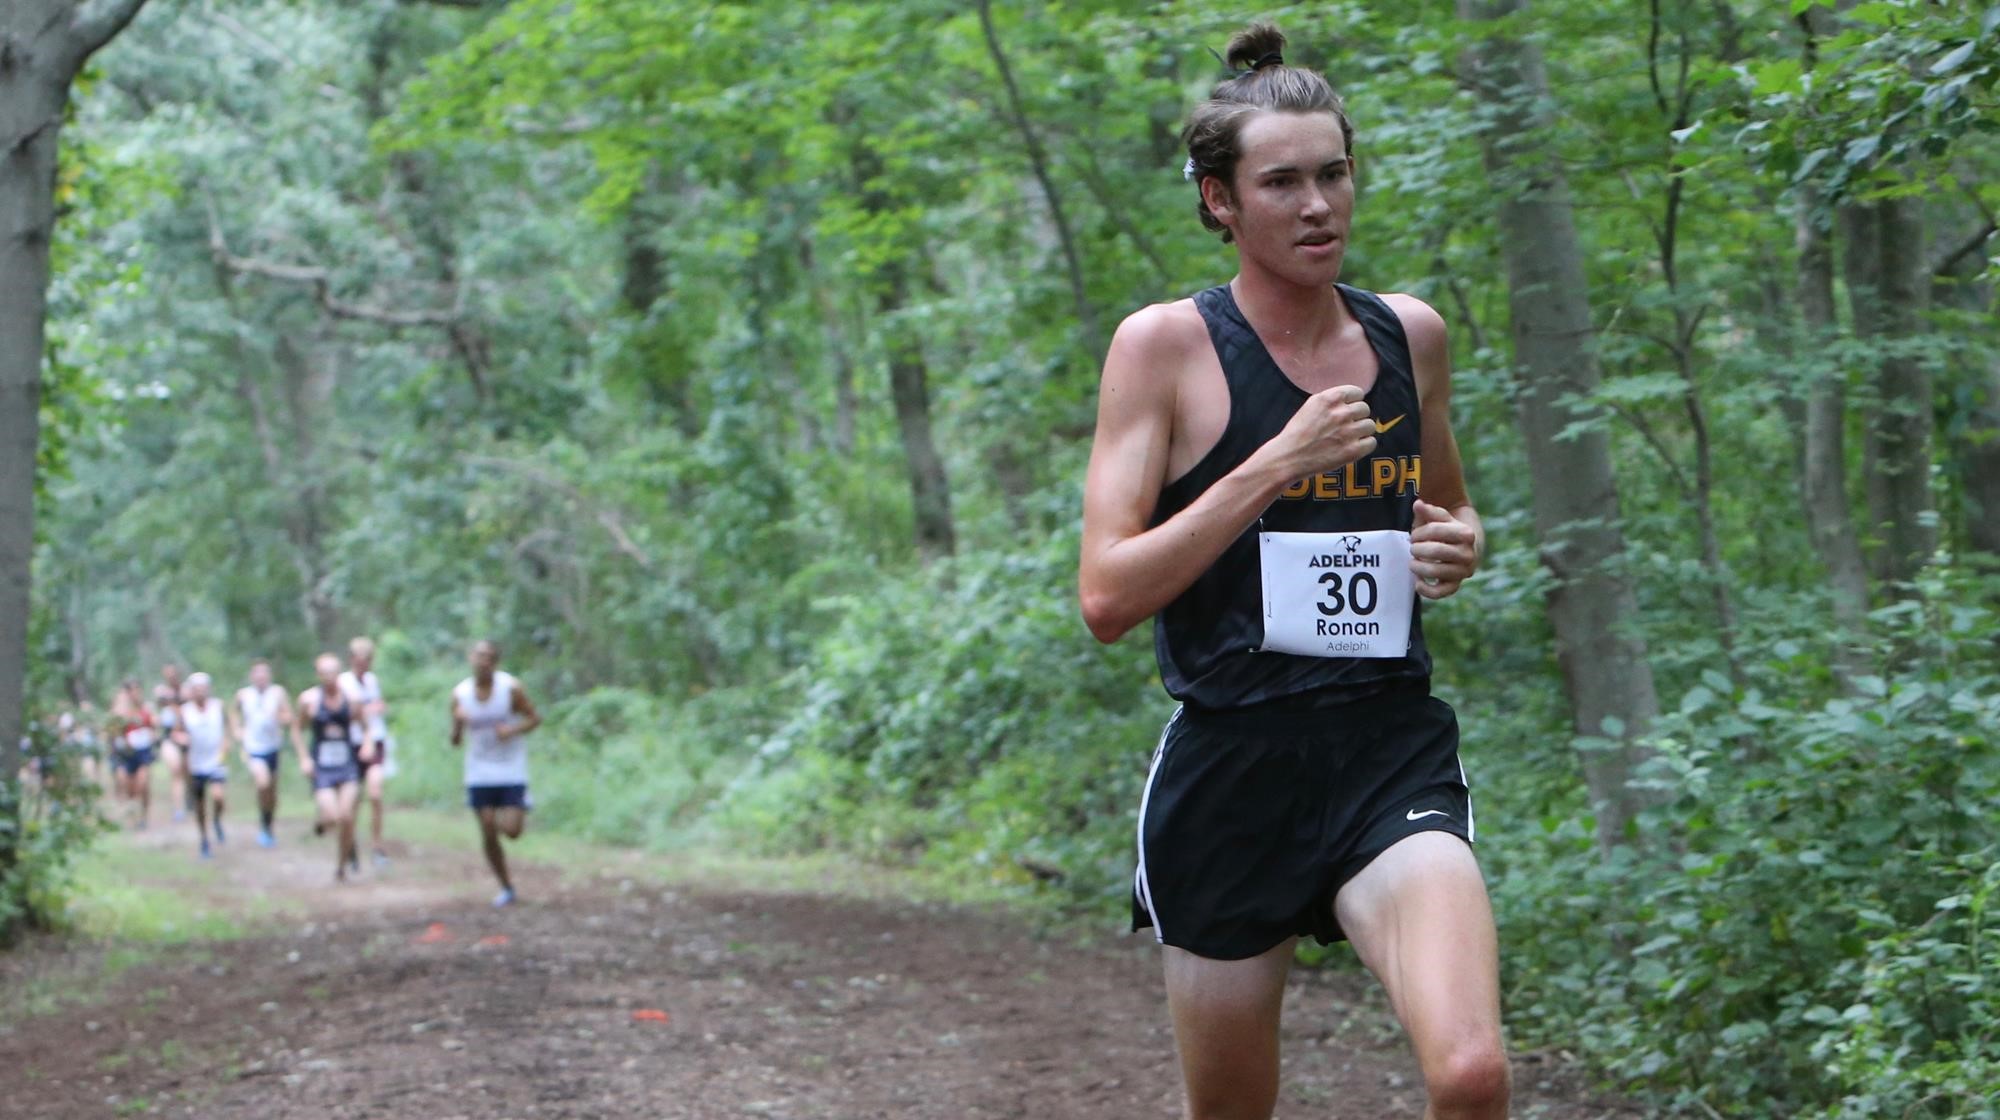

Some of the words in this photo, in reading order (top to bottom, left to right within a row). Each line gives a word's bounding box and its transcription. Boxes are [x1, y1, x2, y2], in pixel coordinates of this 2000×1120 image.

[1309, 554, 1380, 568] ADELPHI
[1316, 571, 1378, 616] 30
[1316, 619, 1380, 636] Ronan
[1326, 640, 1370, 652] Adelphi
